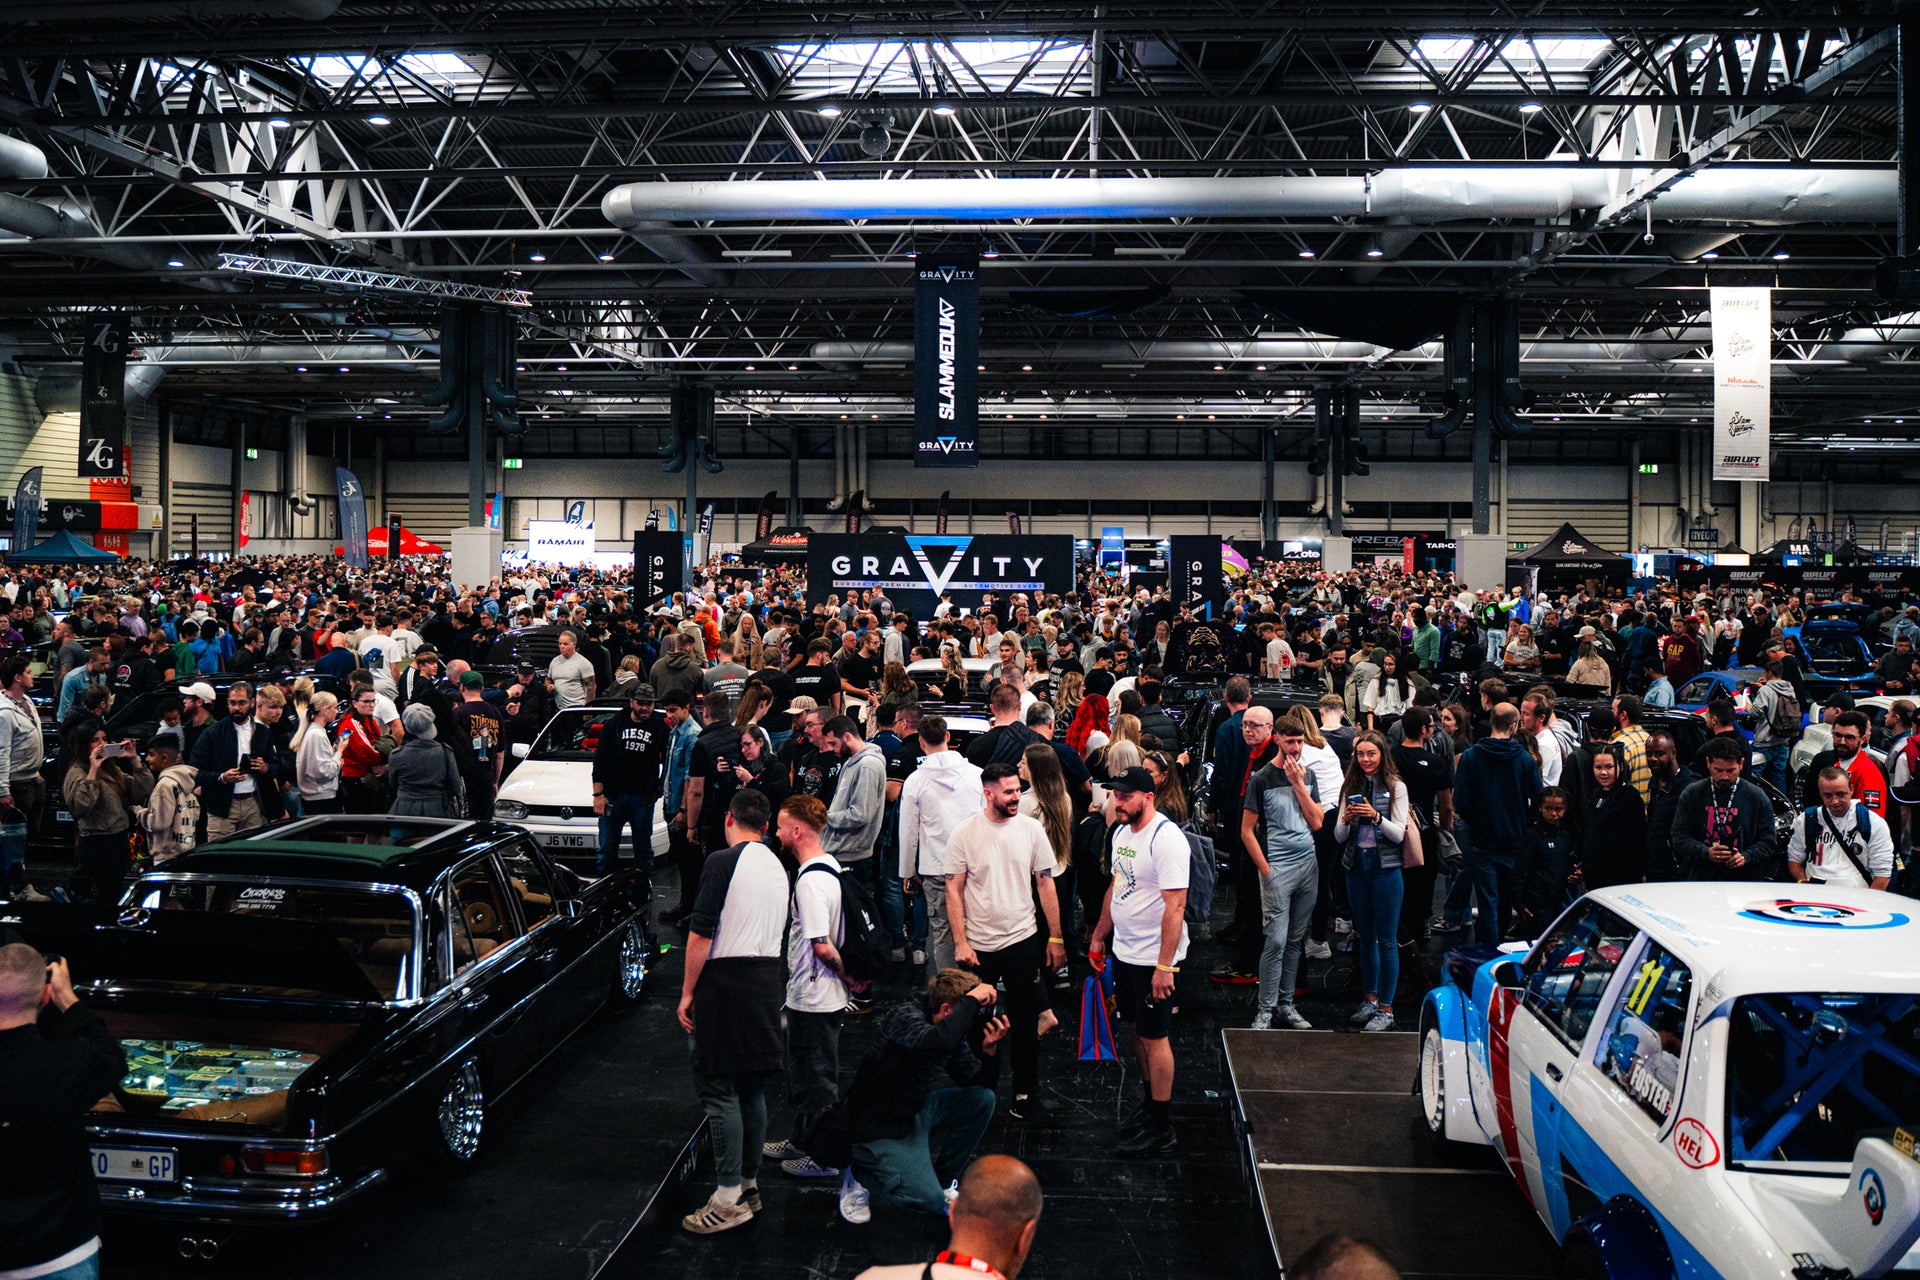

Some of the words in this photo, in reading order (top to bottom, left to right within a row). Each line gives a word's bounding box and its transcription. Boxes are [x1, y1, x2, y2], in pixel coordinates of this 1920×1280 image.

[920, 266, 974, 283] GRAVITY
[939, 298, 955, 420] SLAMMEDUK
[919, 436, 974, 455] GRAVITY
[537, 538, 585, 546] RAMAIR
[1357, 536, 1408, 545] REGA
[831, 536, 1044, 598] GRAVITY
[1668, 644, 1684, 656] GAP
[622, 728, 653, 744] IESE
[625, 740, 646, 752] 1978
[546, 836, 558, 846] J6
[562, 836, 583, 847] VWG
[1630, 1064, 1669, 1116] FOSTER
[1679, 1132, 1701, 1164] HEL
[148, 1156, 171, 1178] GP
